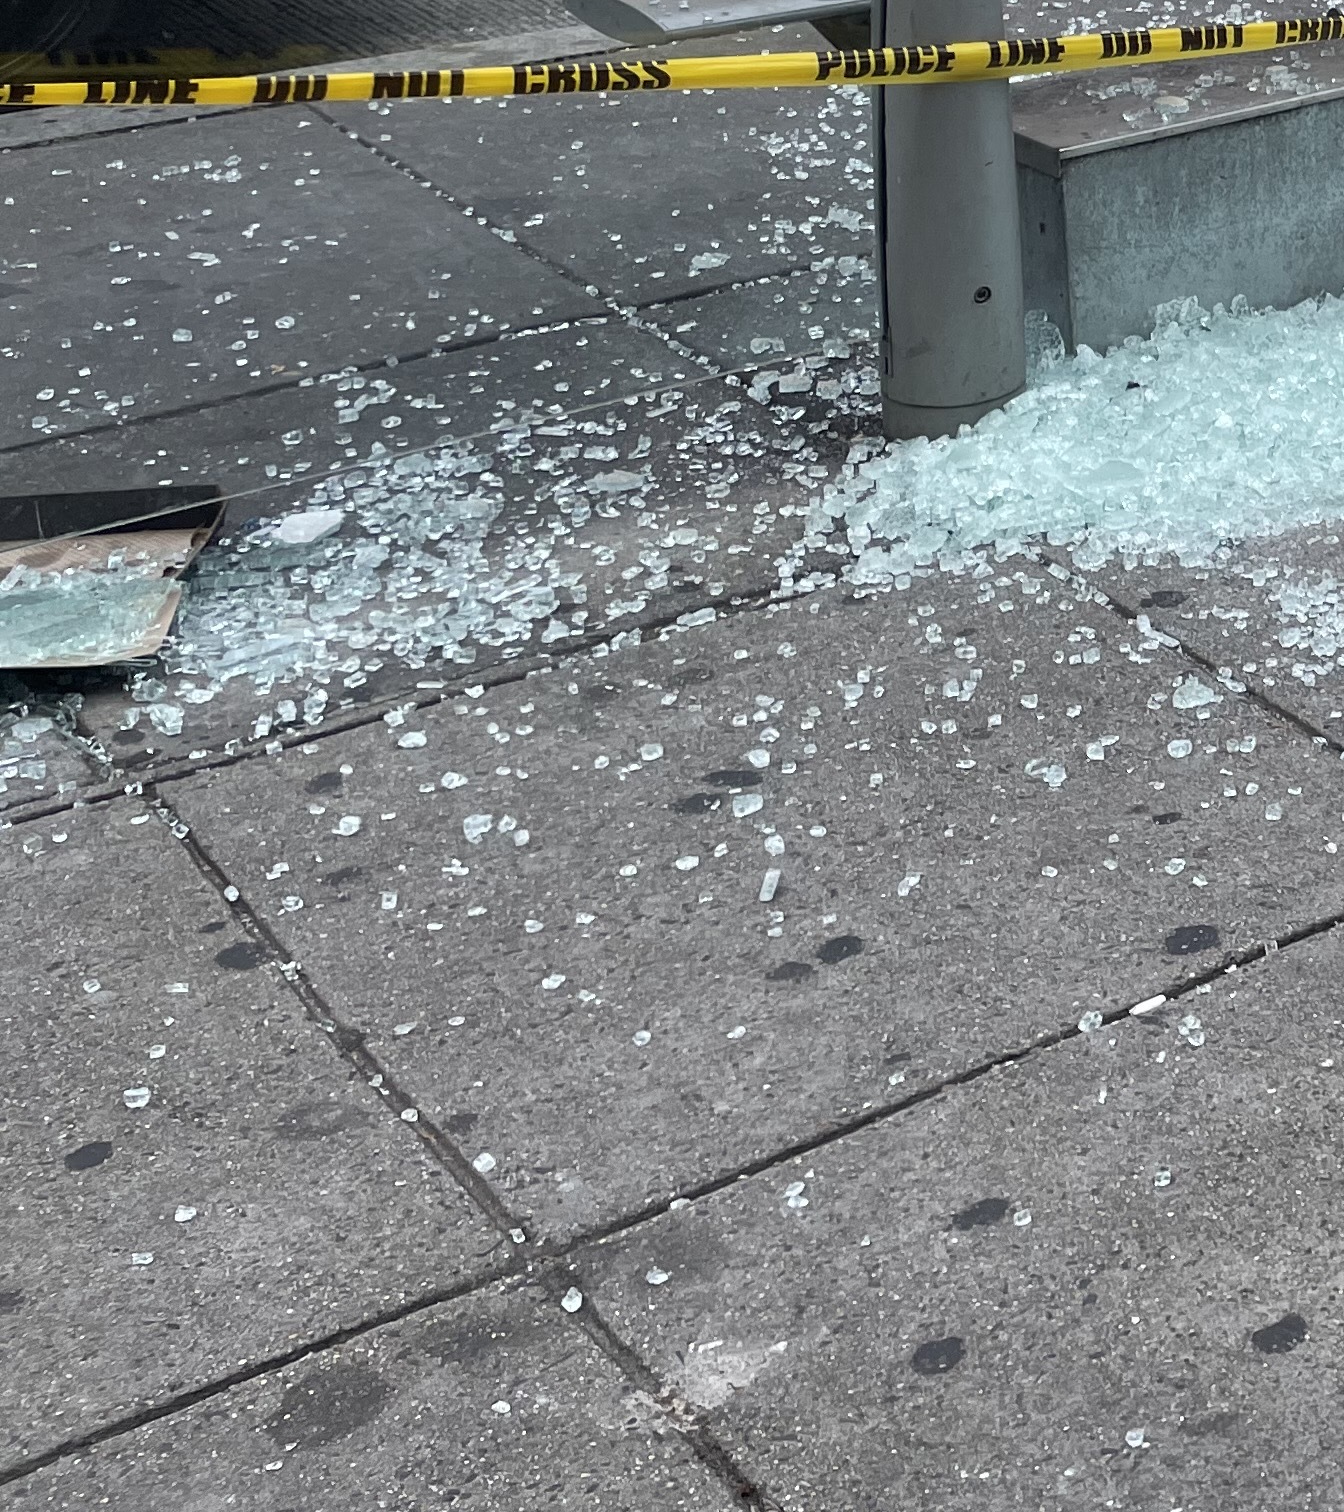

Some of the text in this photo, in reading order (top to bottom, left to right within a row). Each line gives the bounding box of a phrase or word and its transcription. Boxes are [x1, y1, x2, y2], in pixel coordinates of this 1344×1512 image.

[84, 77, 199, 105] LINE
[252, 75, 329, 104] DO
[369, 69, 466, 100] NOT
[513, 60, 672, 97] CROSS
[816, 43, 957, 81] POLICE
[987, 37, 1067, 69] LINE
[1099, 31, 1153, 61] DO
[1178, 23, 1245, 54] NOT
